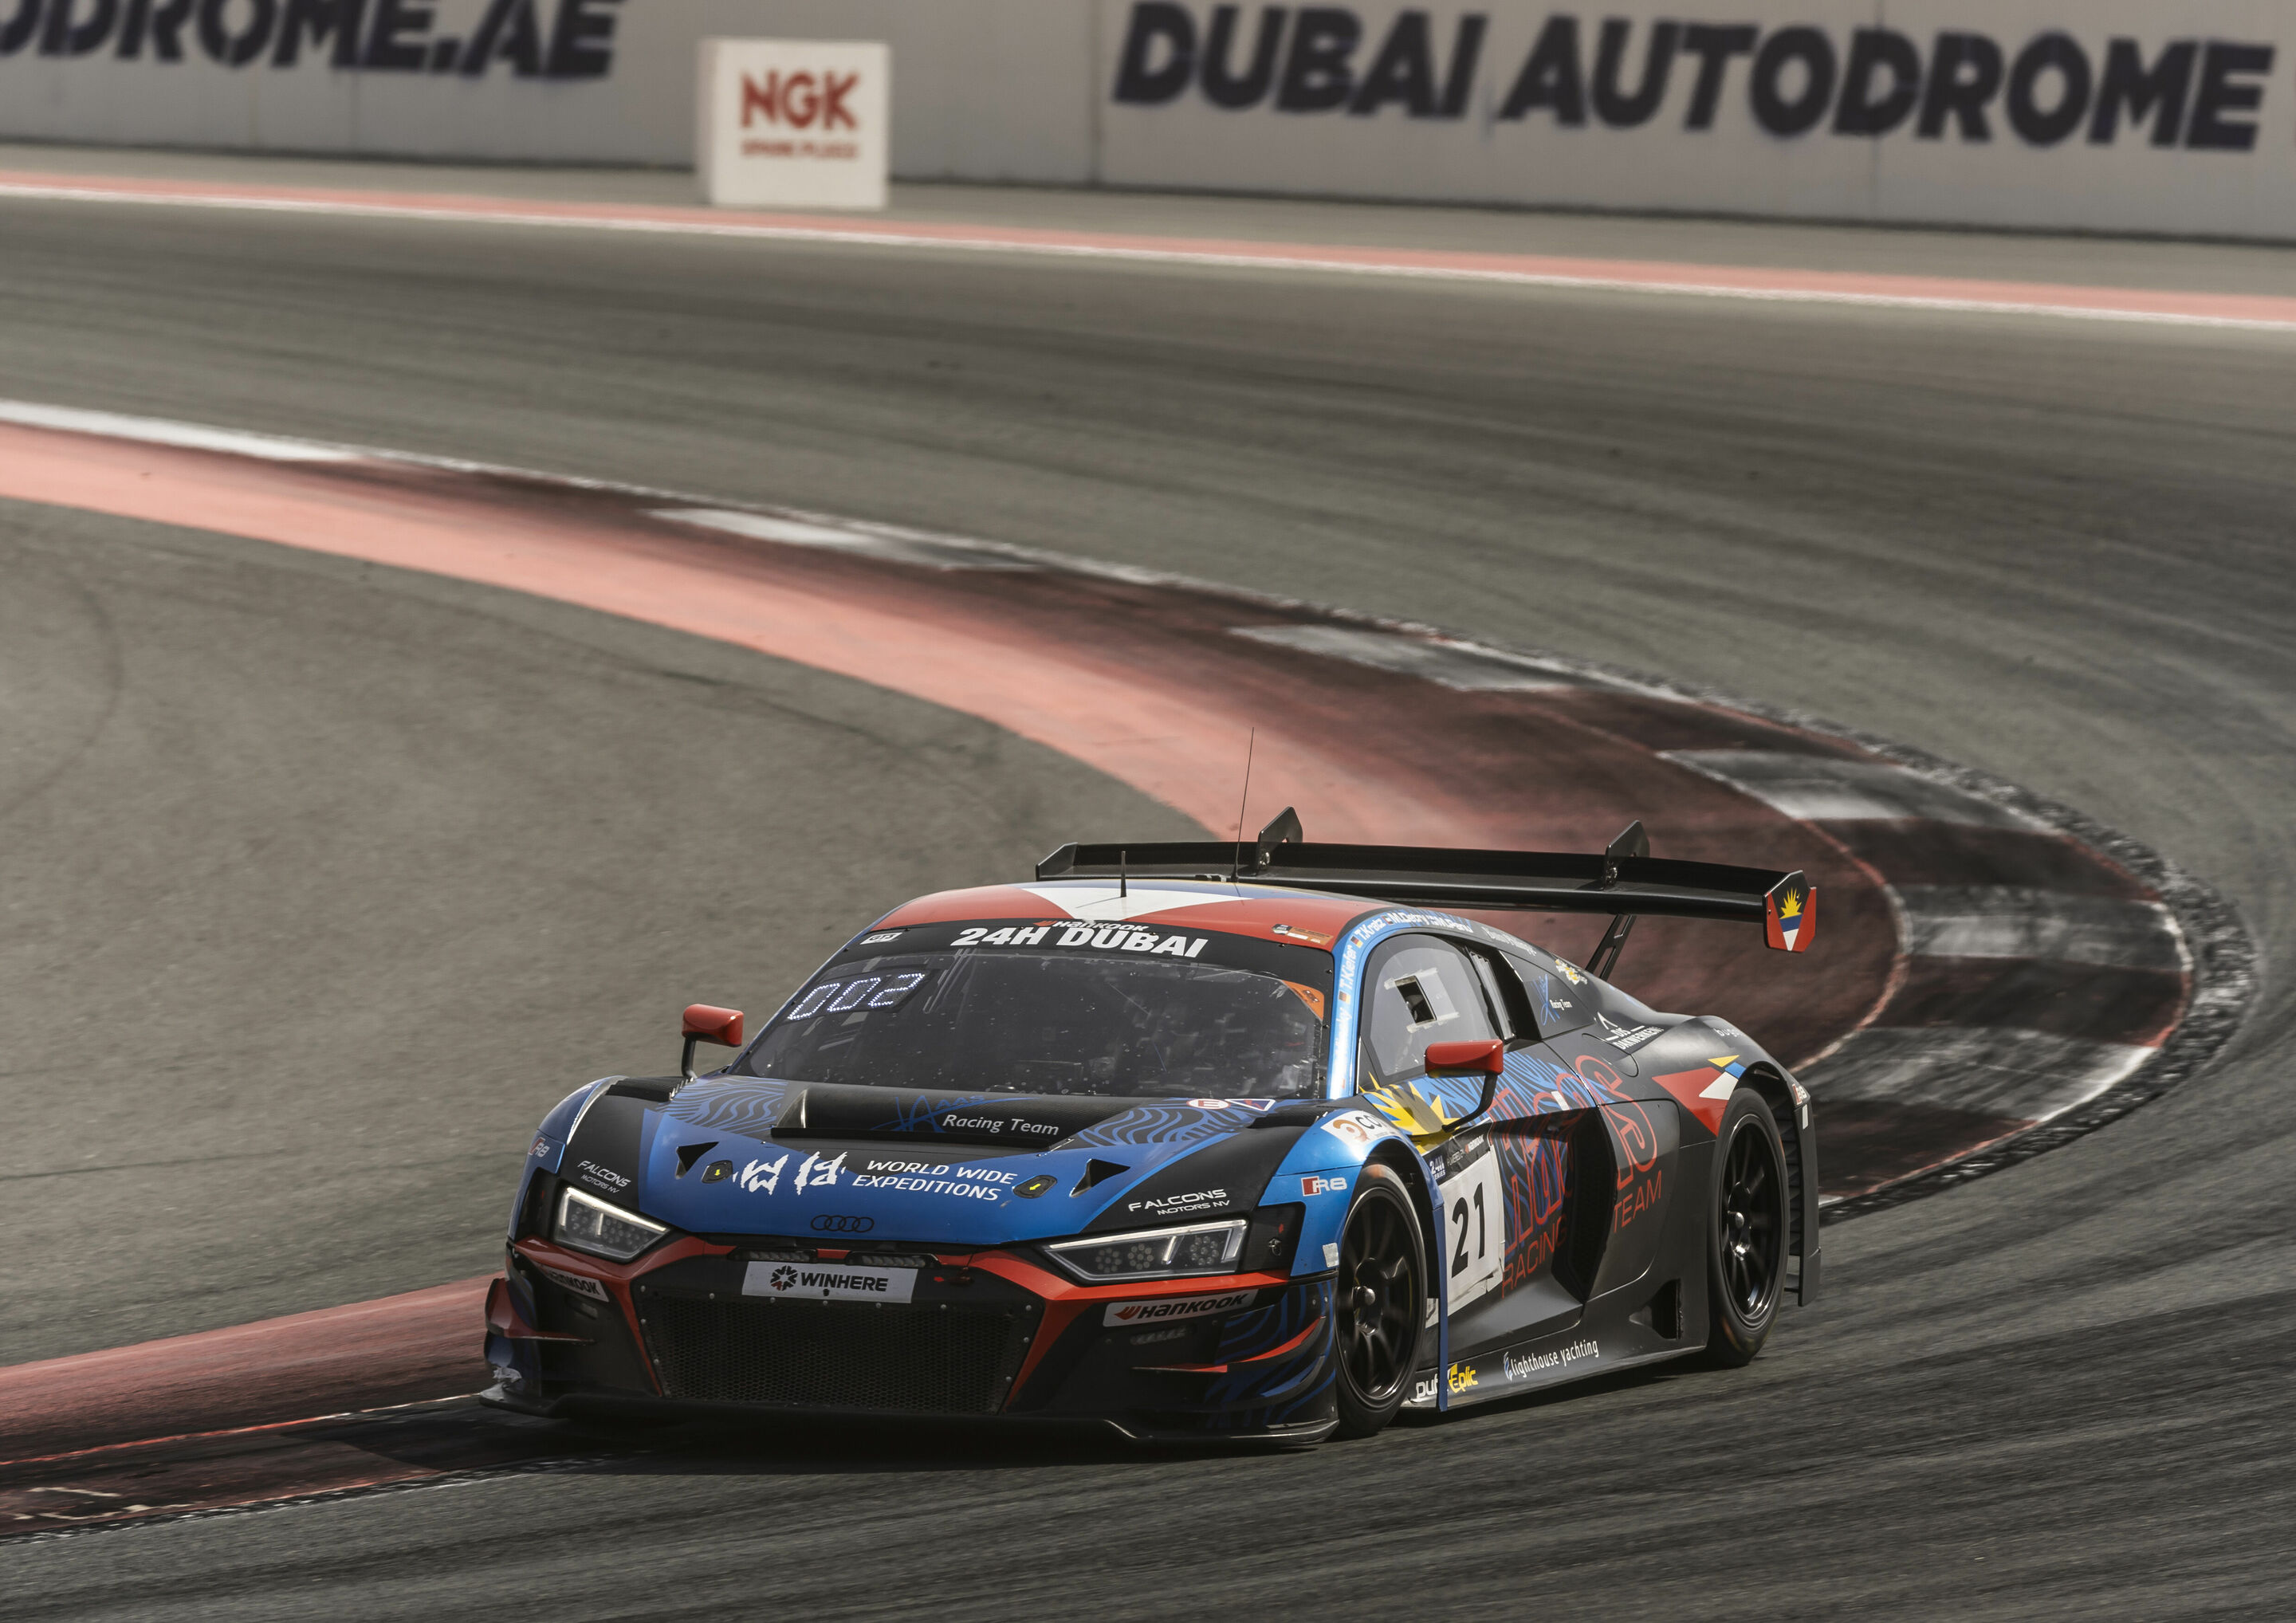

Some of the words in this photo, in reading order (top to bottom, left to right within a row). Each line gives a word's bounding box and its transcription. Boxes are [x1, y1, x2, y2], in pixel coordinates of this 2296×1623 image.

[1111, 2, 1488, 120] DUBAI
[1496, 16, 2275, 151] AUTODROME
[741, 69, 860, 129] NGK
[950, 926, 1049, 946] 24H
[1056, 927, 1209, 958] DUBAI
[787, 973, 926, 1020] 002
[942, 1114, 1005, 1134] Racing
[1010, 1118, 1060, 1136] Team
[577, 1160, 631, 1188] FALCONS
[580, 1174, 609, 1190] MOTORS
[607, 1185, 620, 1194] NV
[867, 1160, 951, 1177] WORLD
[956, 1166, 1019, 1185] WIDE
[1311, 1177, 1347, 1193] R8
[852, 1174, 1002, 1201] EXPEDITIONS
[1128, 1189, 1227, 1212] FALCONS
[1613, 1169, 1663, 1234] TEAM
[1157, 1202, 1211, 1216] MOTORS
[1451, 1181, 1485, 1279] 21
[1501, 1213, 1569, 1299] RACING
[801, 1271, 889, 1292] WINHERE
[1511, 1351, 1559, 1377] lighthouse
[1560, 1338, 1600, 1367] yachting
